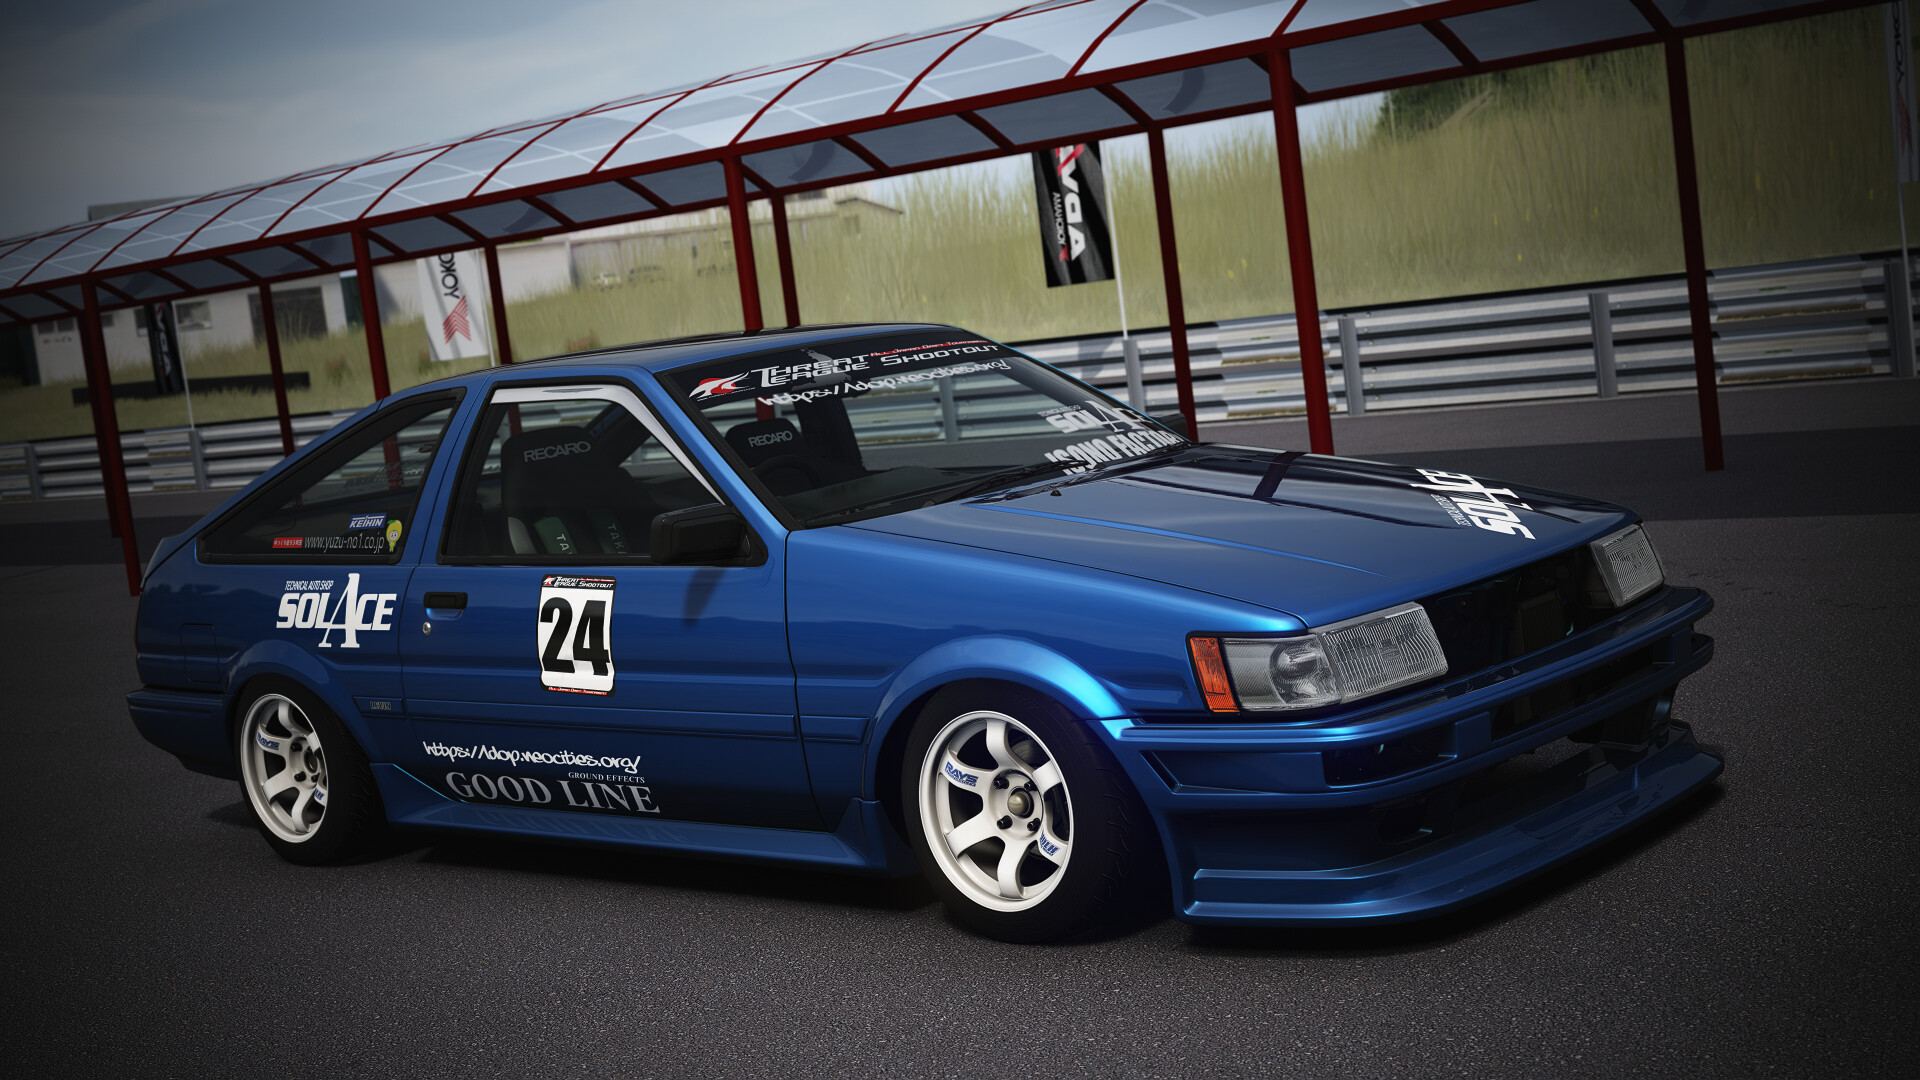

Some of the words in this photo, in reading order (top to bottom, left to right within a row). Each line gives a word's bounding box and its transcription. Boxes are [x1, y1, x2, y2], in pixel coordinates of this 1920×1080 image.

[751, 354, 869, 380] THREAT
[760, 361, 870, 388] LEAGUE
[880, 345, 1000, 367] SHOOTOUT
[748, 430, 793, 447] RECARO
[523, 440, 592, 463] RECARO
[349, 517, 384, 528] KEIHIN
[304, 533, 385, 554] www.yuzu-no1.co.jp
[579, 580, 614, 588] SHOOTOUT
[276, 572, 398, 648] SOLACE
[540, 597, 611, 676] 24
[257, 732, 281, 749] RAYS
[568, 771, 604, 781] GROUND
[606, 773, 645, 784] EFFECTS
[945, 760, 979, 784] RAYS
[445, 771, 552, 804] GOOD
[557, 779, 661, 814] LINE
